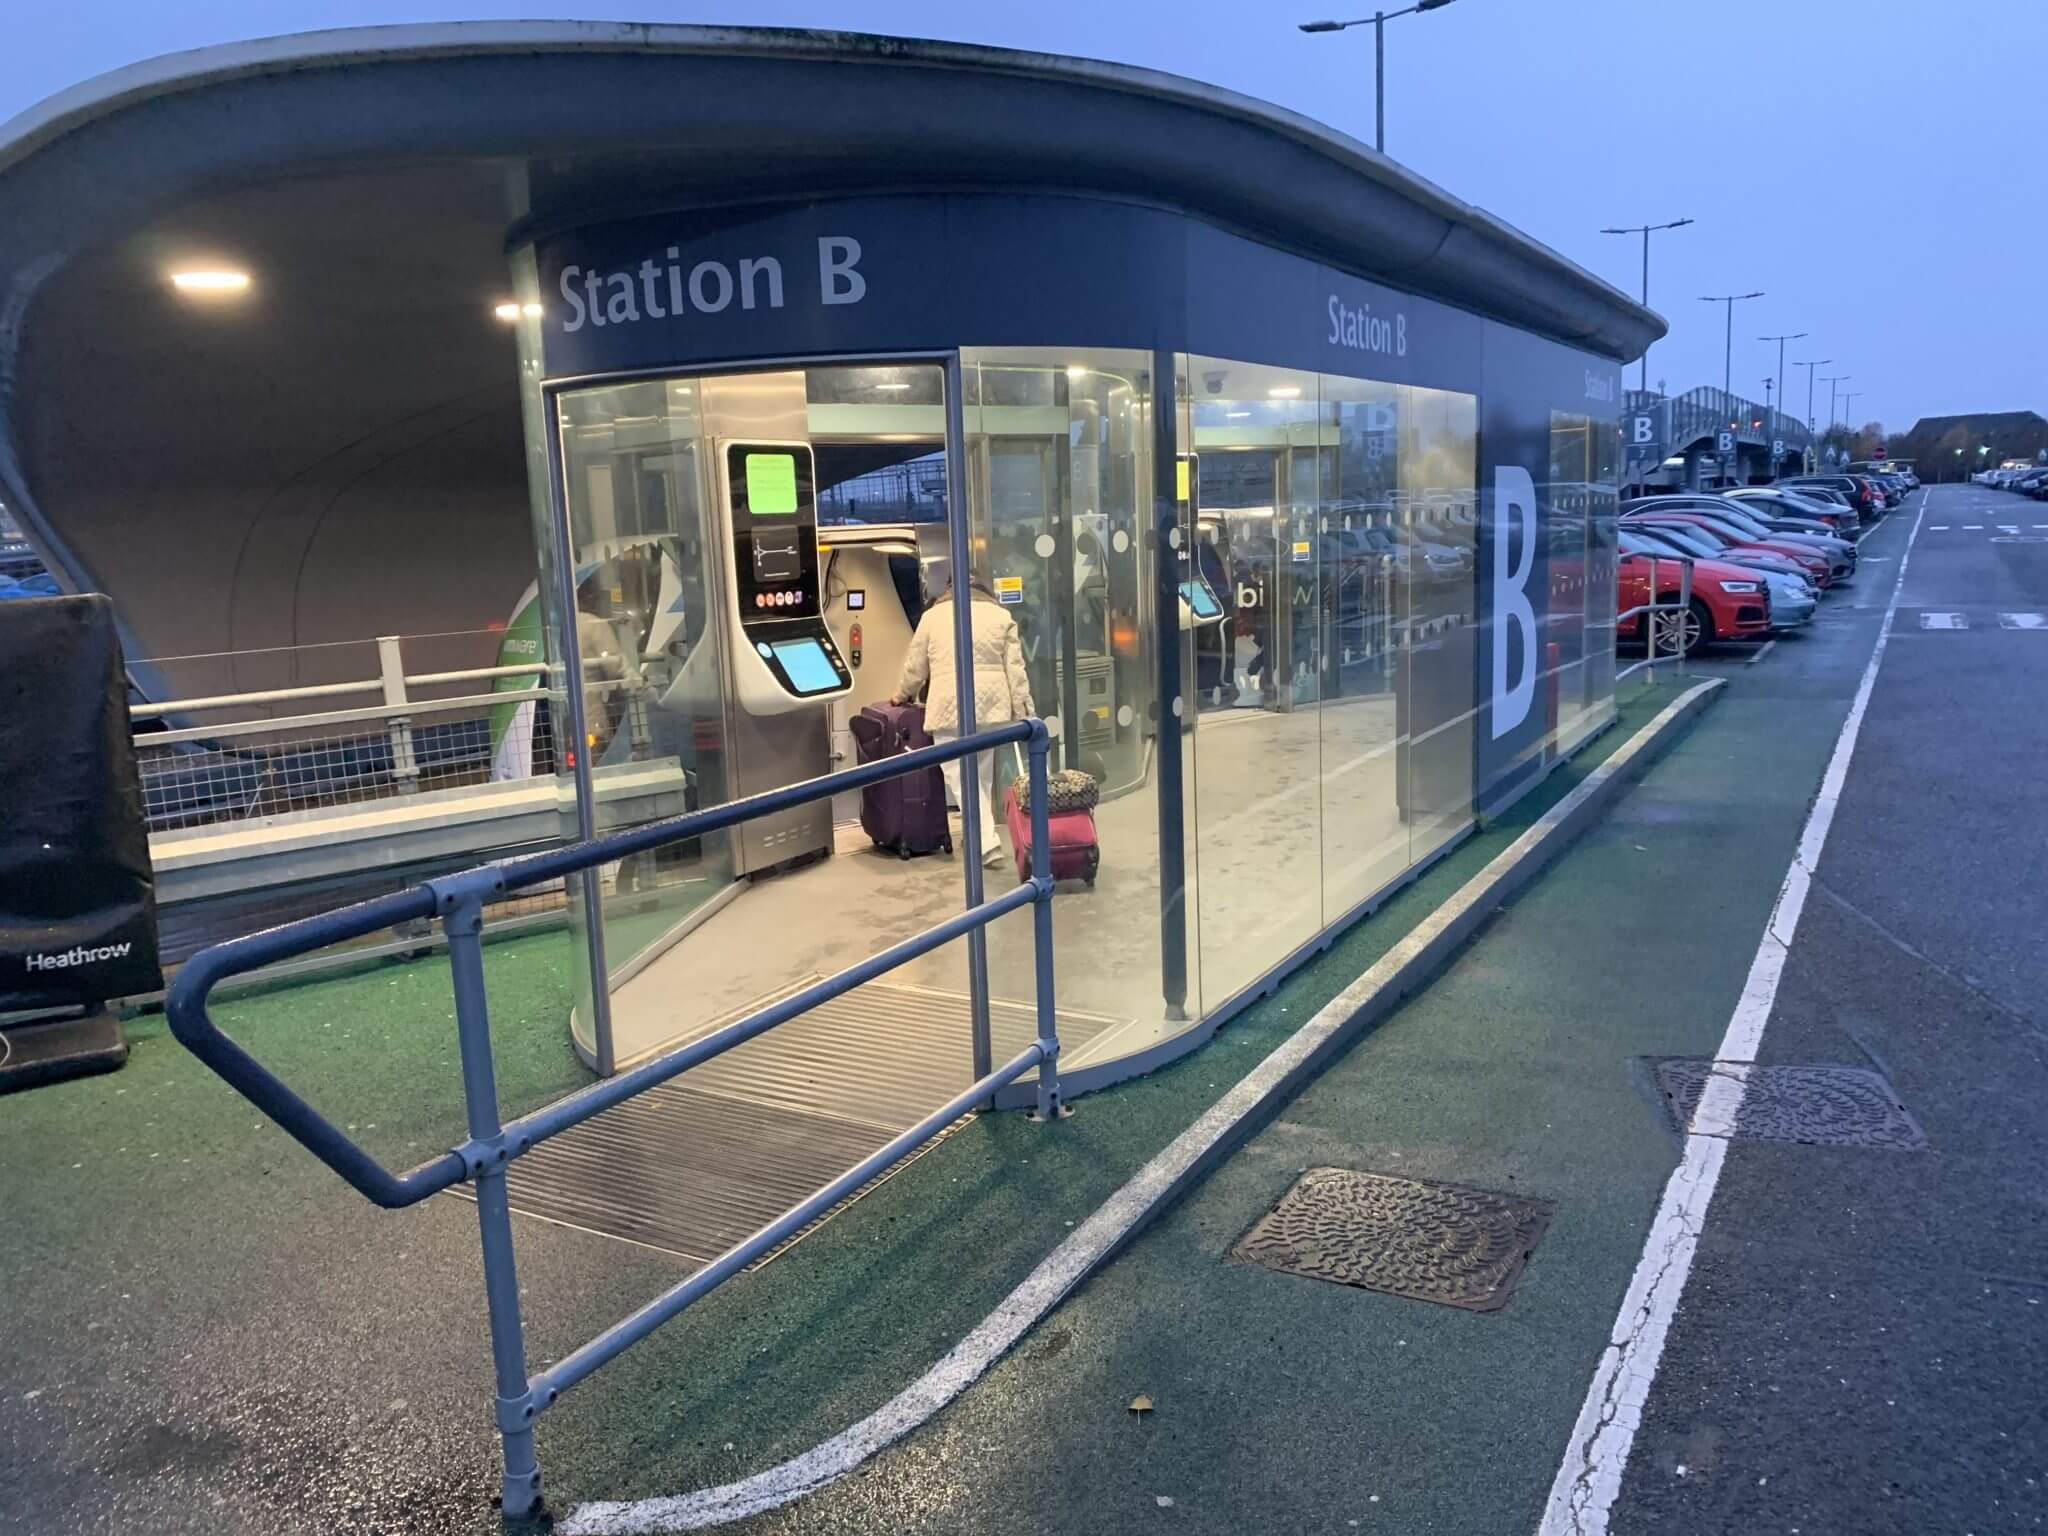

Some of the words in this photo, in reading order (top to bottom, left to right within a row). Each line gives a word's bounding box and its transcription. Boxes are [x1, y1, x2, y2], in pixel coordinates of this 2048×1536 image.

[559, 246, 784, 333] Station
[817, 235, 867, 306] B
[1328, 295, 1391, 354] Station
[1397, 313, 1406, 357] B
[1633, 417, 1653, 443] B
[1719, 432, 1733, 451] B
[1772, 440, 1784, 454] B
[1492, 465, 1537, 740] B
[26, 942, 131, 972] Heathrow
